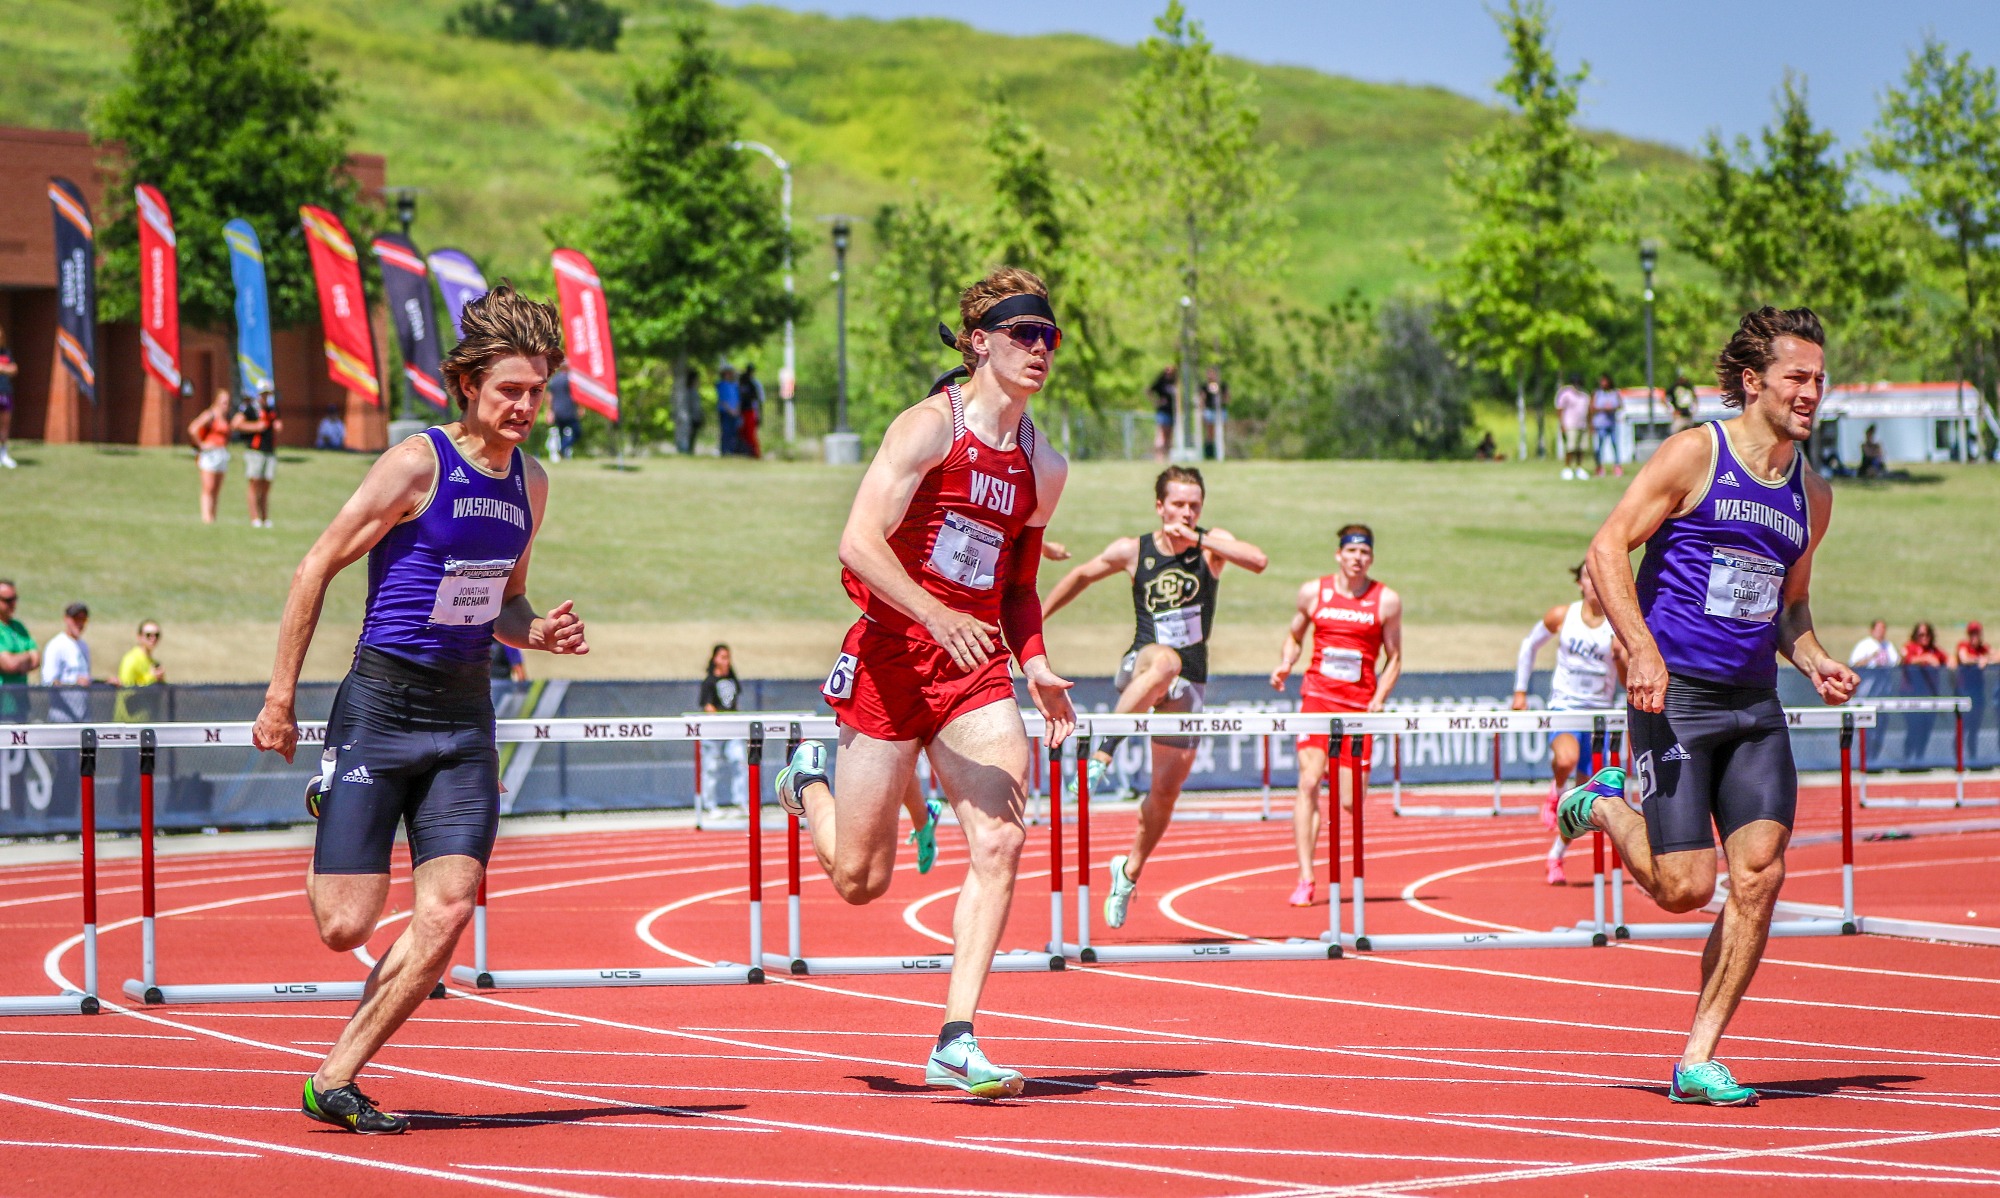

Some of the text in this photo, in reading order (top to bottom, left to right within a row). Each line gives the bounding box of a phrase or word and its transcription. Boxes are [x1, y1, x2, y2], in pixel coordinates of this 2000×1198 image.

[448, 475, 470, 485] adidas
[1717, 478, 1740, 488] adidas
[969, 469, 1016, 516] WSU
[452, 497, 526, 531] WASHINGTON
[1714, 498, 1804, 550] WASHINGTON
[459, 586, 490, 596] JONATHAN
[1740, 579, 1756, 591] CASS
[1733, 588, 1761, 601] ELLIOTT
[1314, 607, 1375, 626] ARIZONA
[1739, 608, 1750, 617] W
[464, 615, 474, 624] W
[830, 655, 849, 695] 6
[1134, 718, 1286, 732] M MT. SAC M
[1405, 716, 1552, 730] M MT. SAC M
[205, 728, 221, 743] M
[534, 723, 701, 739] M MT. SAC M
[11, 730, 29, 746] M
[1661, 753, 1692, 762] adidas
[341, 774, 374, 785] adidas
[1193, 946, 1231, 955] UCS
[901, 959, 942, 969] UCS
[600, 970, 641, 979] UCS
[274, 984, 318, 994] UCS
